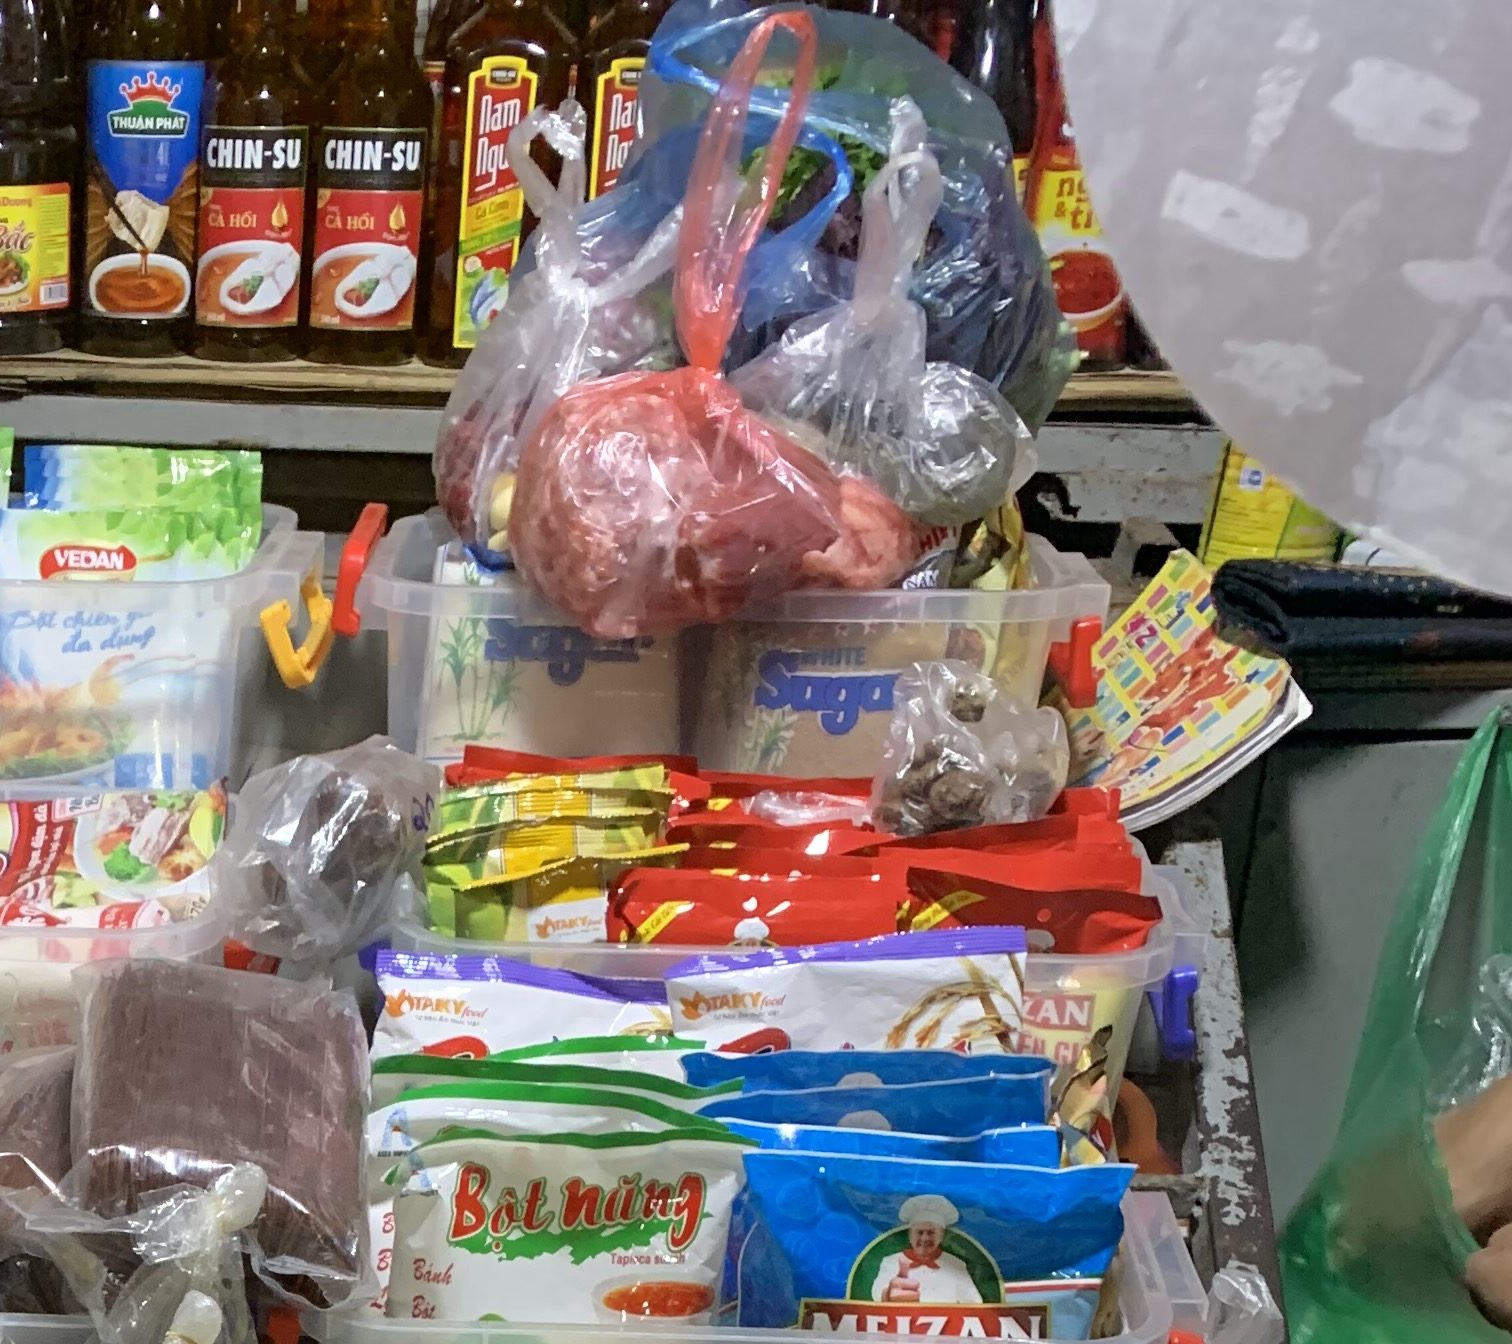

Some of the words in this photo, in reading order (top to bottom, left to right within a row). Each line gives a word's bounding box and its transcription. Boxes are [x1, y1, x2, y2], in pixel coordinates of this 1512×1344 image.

[479, 95, 521, 135] Nam
[207, 138, 301, 169] CHIN-SU
[325, 139, 421, 171] CHIN-SU
[54, 549, 124, 570] VEDAN
[448, 1161, 554, 1253] Bột
[560, 1171, 706, 1254] năng
[412, 1258, 454, 1286] Bánh
